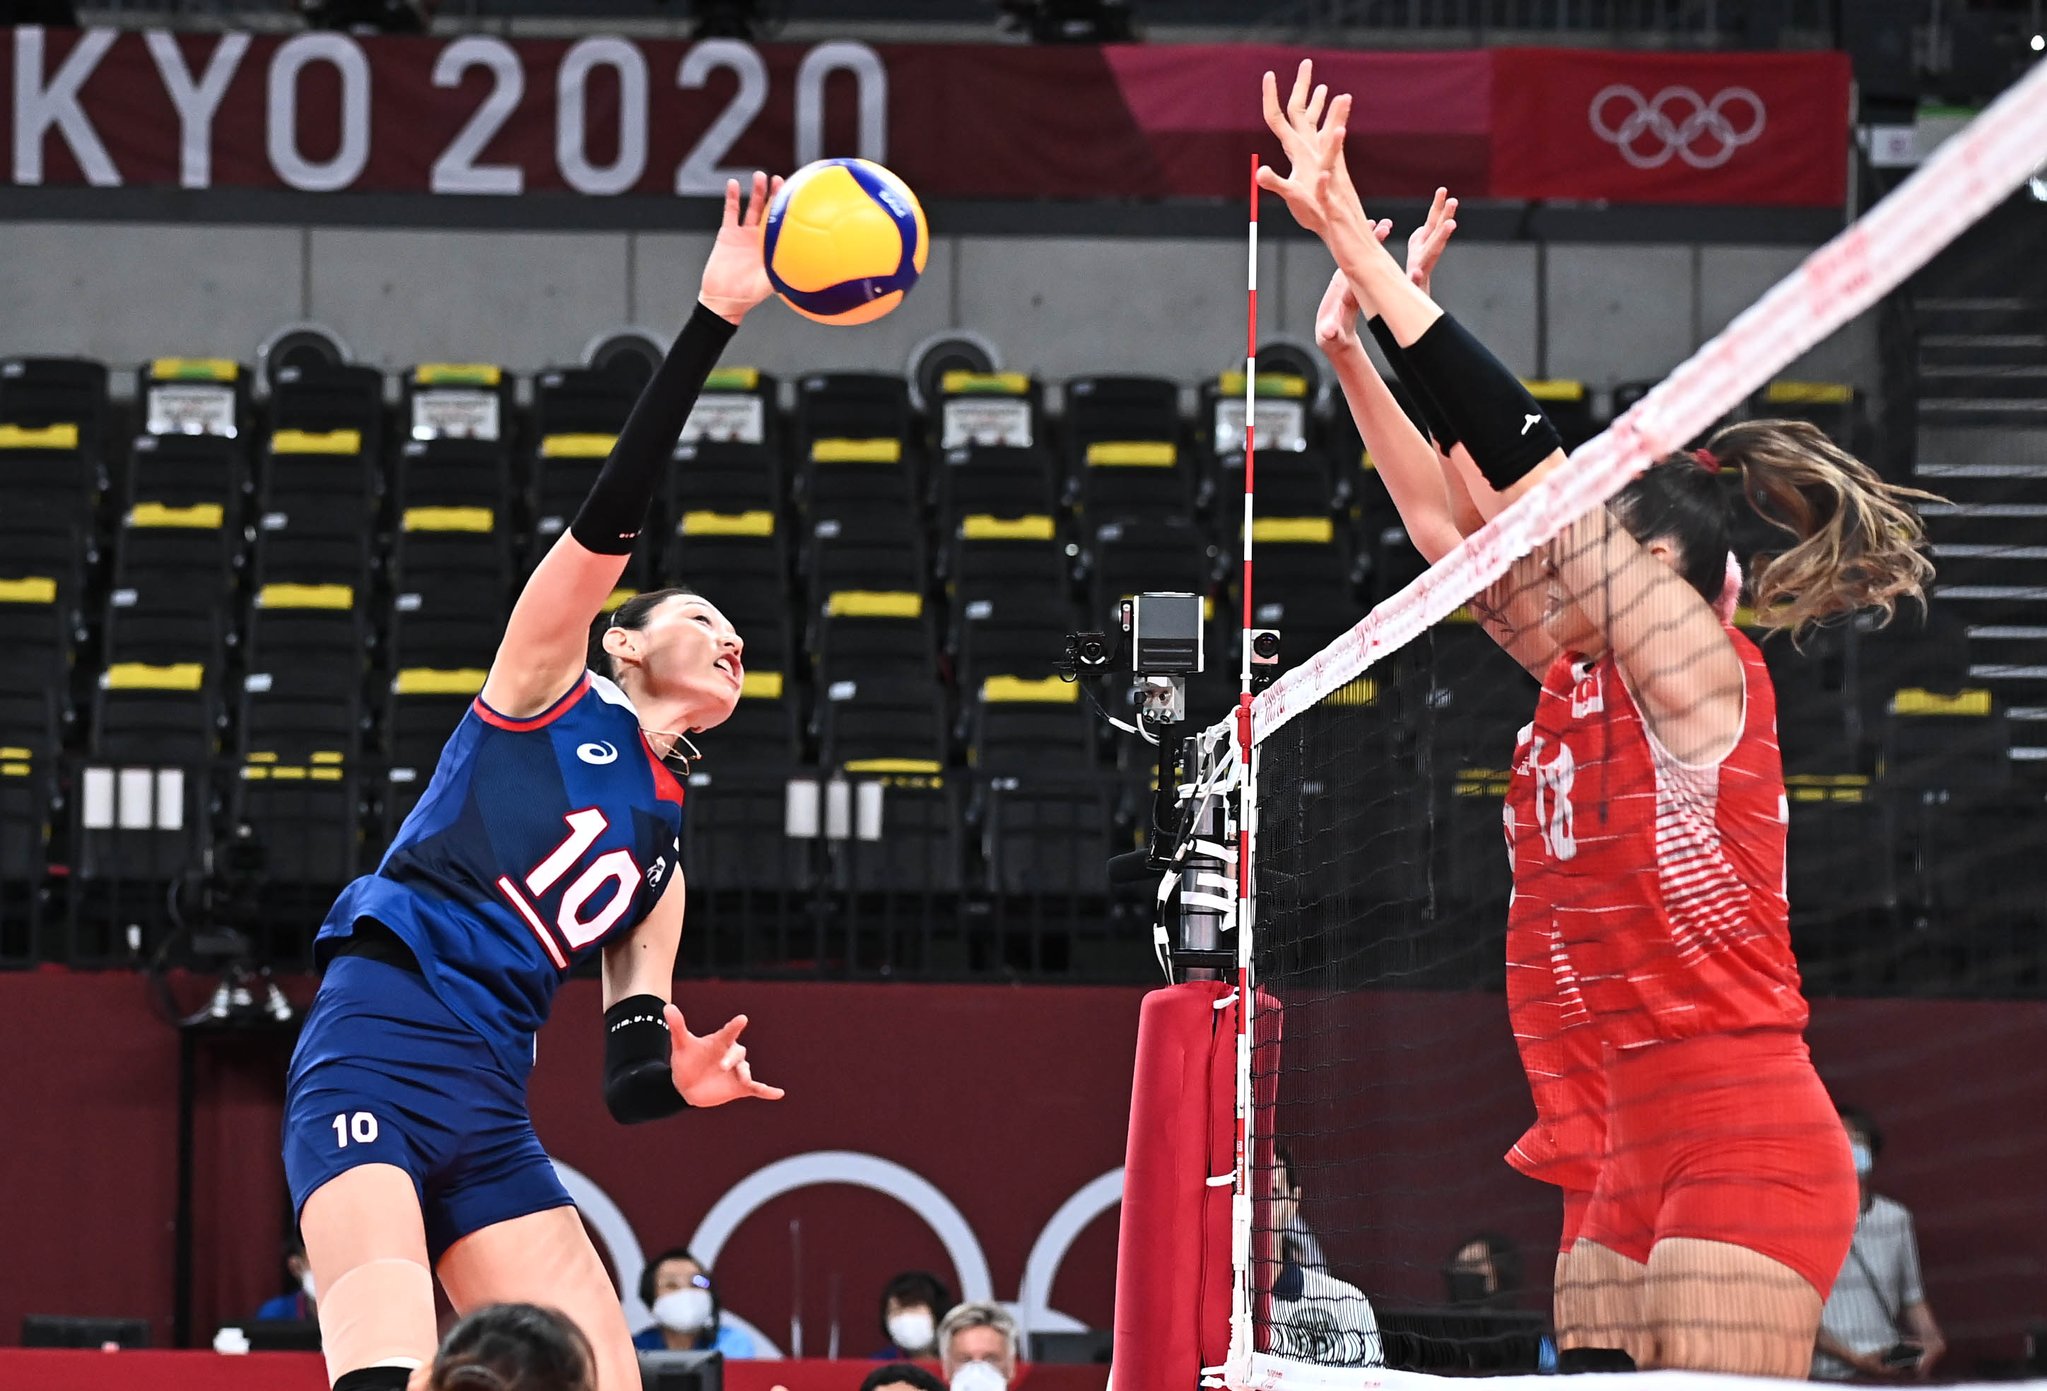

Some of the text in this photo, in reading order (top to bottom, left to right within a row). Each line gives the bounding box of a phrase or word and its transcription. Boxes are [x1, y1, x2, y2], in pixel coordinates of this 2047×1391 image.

[14, 24, 888, 197] KYO 2020
[524, 804, 643, 951] 10
[332, 1111, 378, 1148] 10
